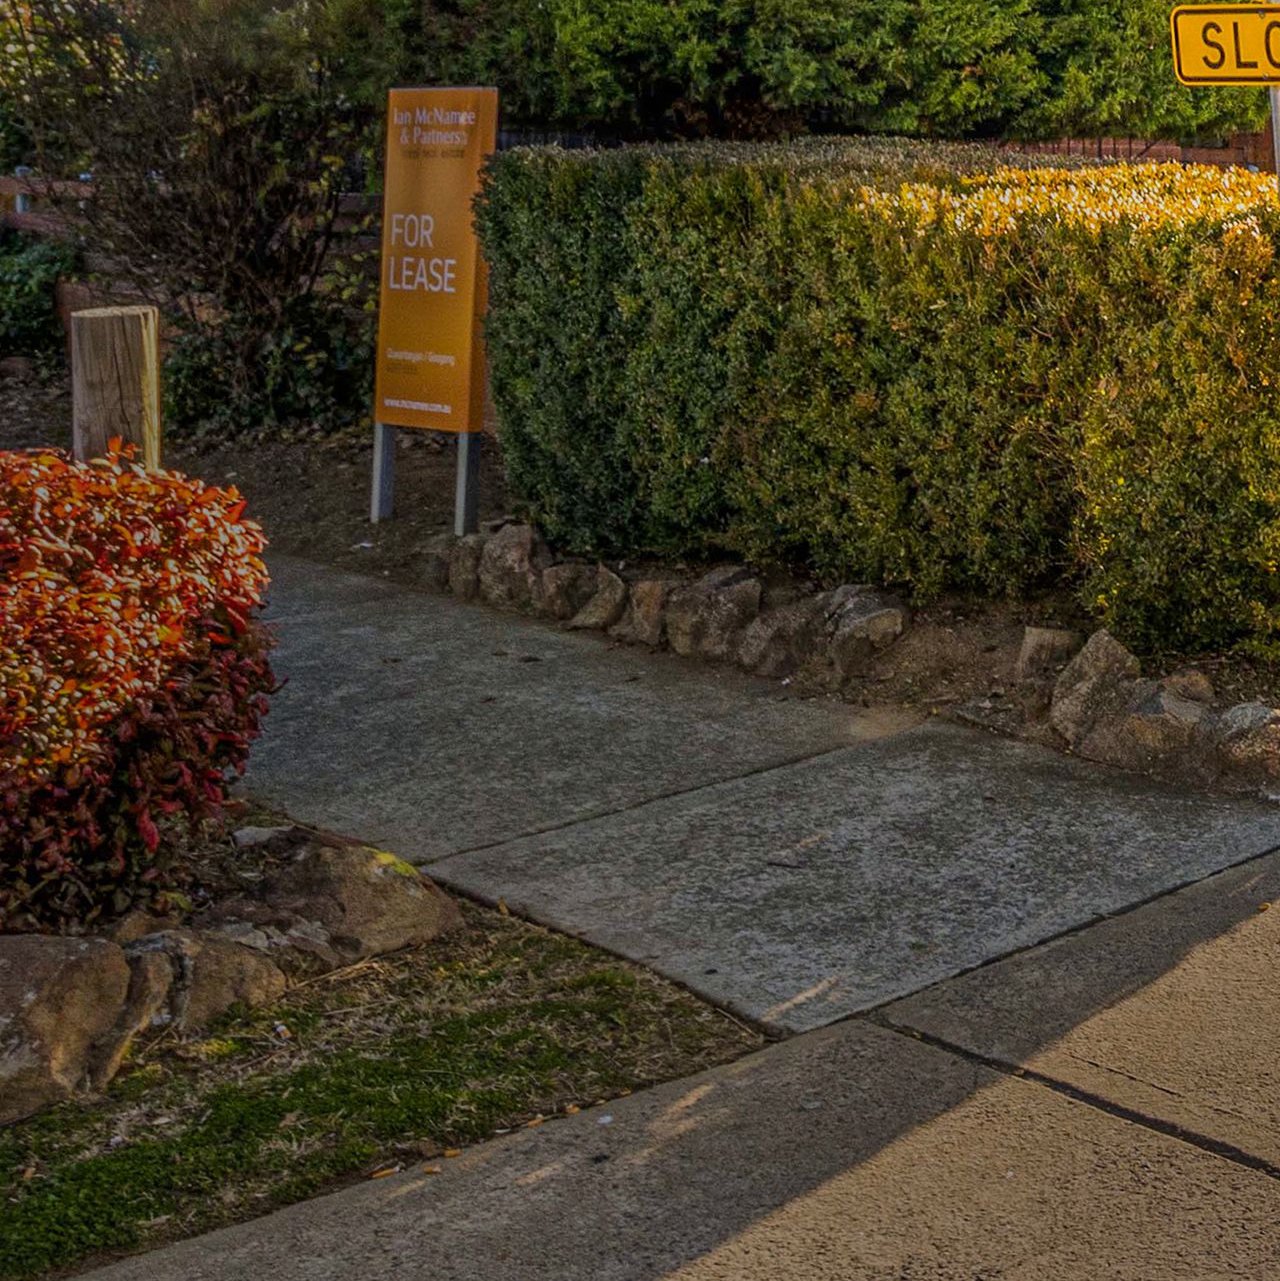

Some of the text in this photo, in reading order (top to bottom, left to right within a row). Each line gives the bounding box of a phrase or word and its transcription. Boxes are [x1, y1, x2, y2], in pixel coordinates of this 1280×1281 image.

[393, 107, 476, 126] Ian McNamee
[400, 126, 462, 145] & Partners
[391, 214, 433, 248] FOR
[389, 256, 456, 292] LEASE
